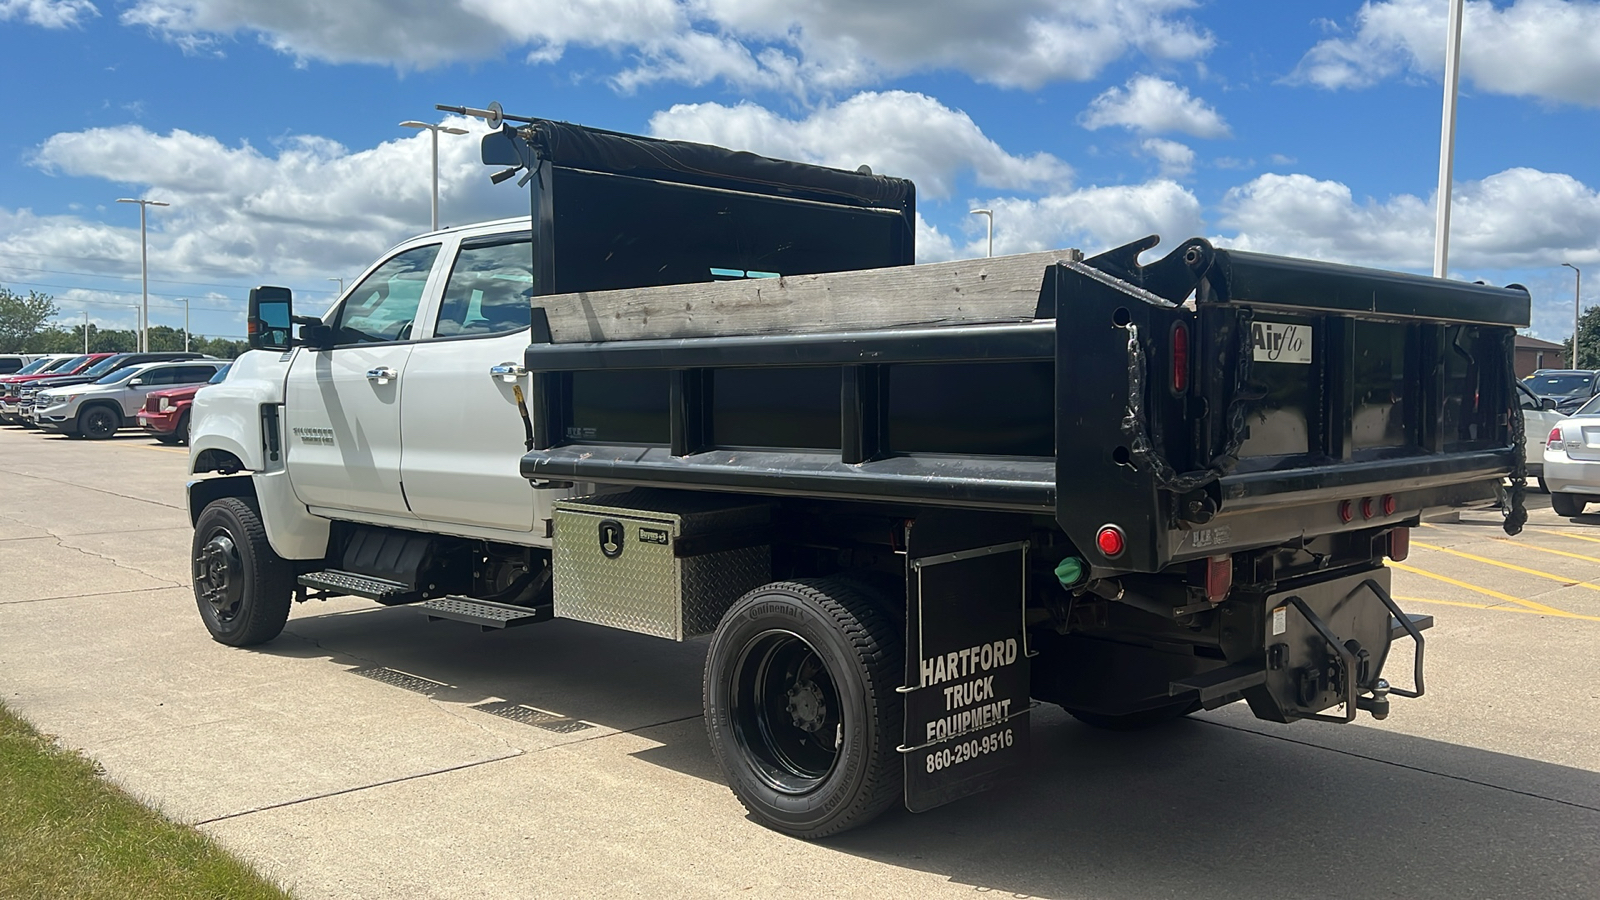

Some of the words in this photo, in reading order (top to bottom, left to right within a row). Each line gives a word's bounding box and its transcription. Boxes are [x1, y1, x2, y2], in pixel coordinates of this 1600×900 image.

[1252, 323, 1302, 361] Airflo
[749, 602, 798, 620] Continental
[921, 638, 1018, 688] HARTFORD
[943, 675, 994, 711] TRUCK
[926, 698, 1011, 744] EQUIPMENT
[926, 728, 1014, 773] 860-290-9516
